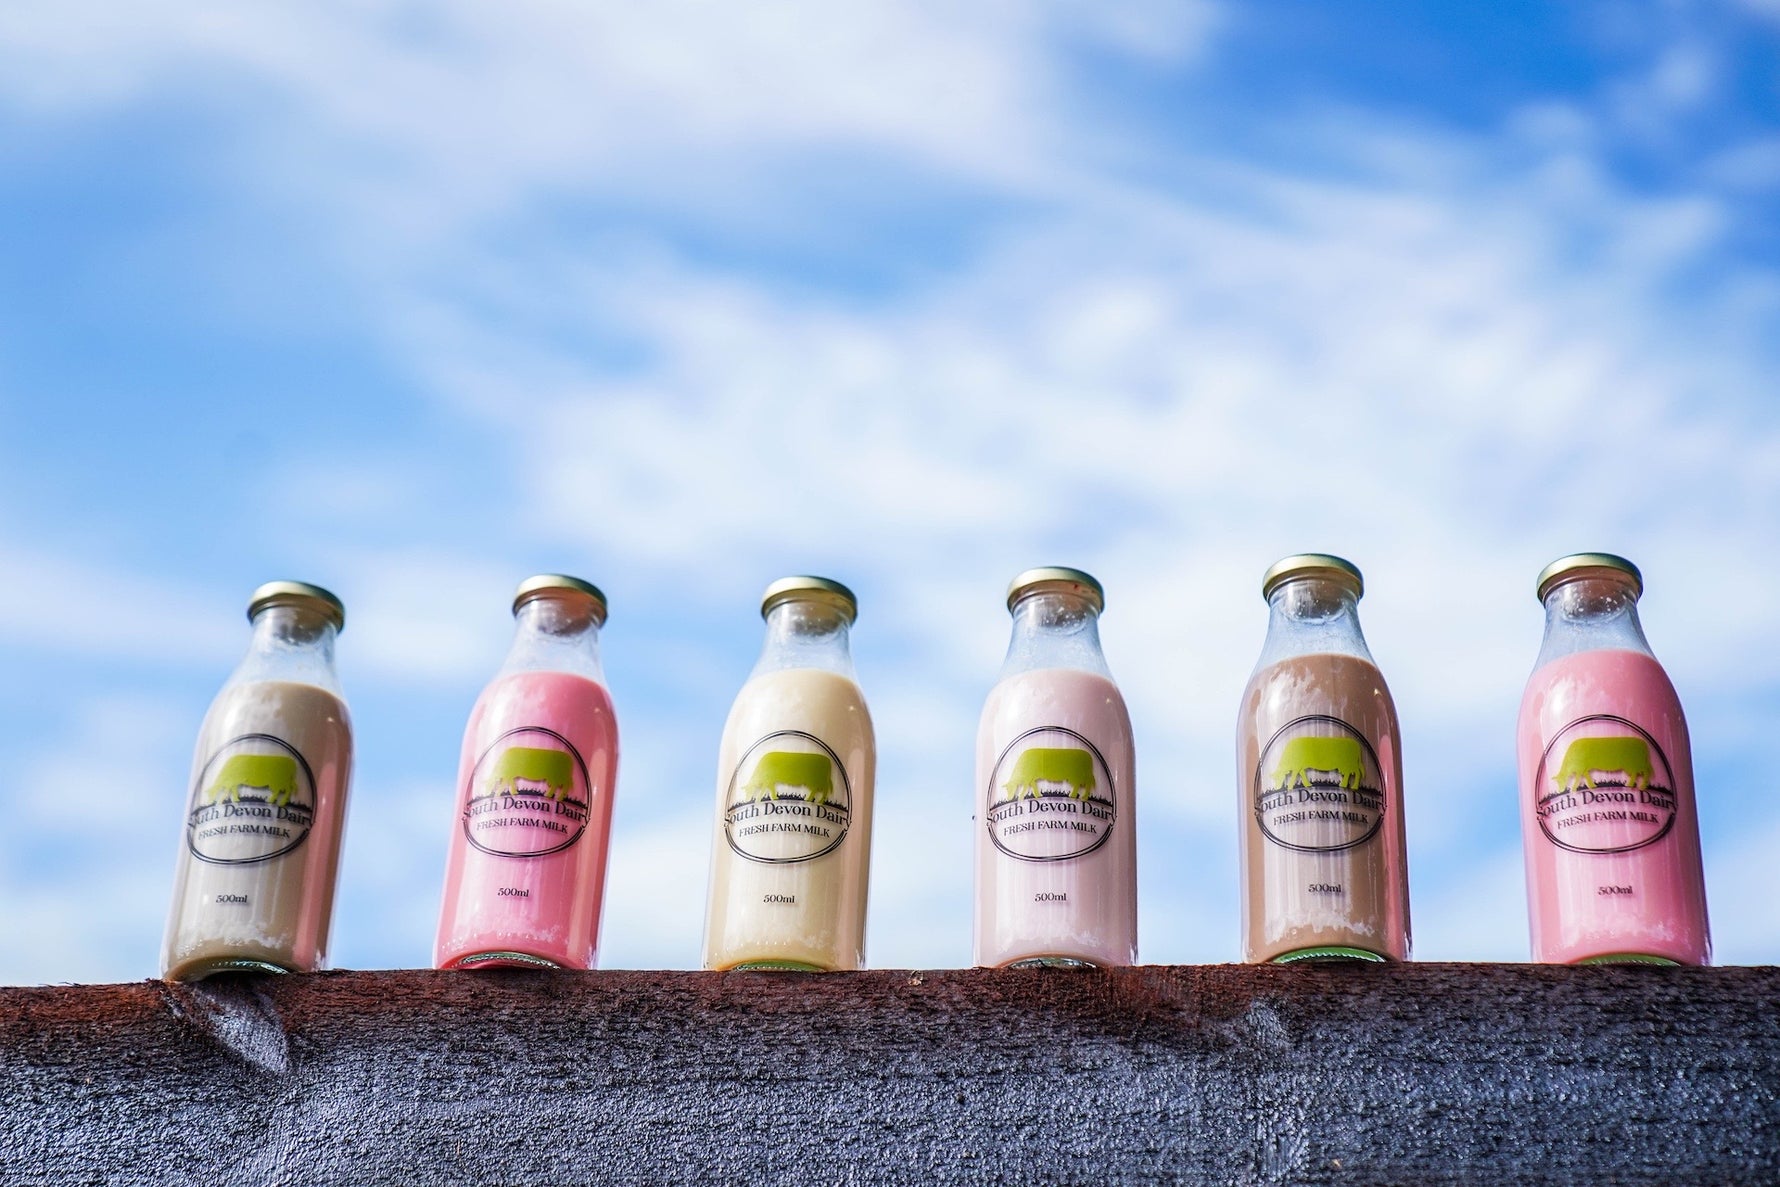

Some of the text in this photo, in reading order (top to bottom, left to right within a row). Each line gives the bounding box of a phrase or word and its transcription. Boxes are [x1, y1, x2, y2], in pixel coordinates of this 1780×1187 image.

[1298, 788, 1348, 804] Devon
[1582, 790, 1636, 805] Devon
[503, 796, 550, 813] Devon
[764, 801, 811, 816] Devon
[1028, 799, 1077, 814] Devon
[187, 807, 219, 829] uth
[223, 804, 272, 819] Devon
[1273, 810, 1369, 826] FRESH FARM MILK
[1557, 810, 1660, 829] FRESH FARM MILK
[198, 824, 291, 840] FRESH FARM MILK
[476, 817, 569, 835] FRESH FARM MILK
[739, 822, 831, 839] FRESH FARM MILK
[1003, 820, 1098, 837] FRESH FARM MILK
[497, 887, 530, 898] 500ml
[1308, 883, 1342, 893] 500ml
[1597, 885, 1634, 895] 500ml
[215, 894, 248, 904] 500ml
[763, 894, 795, 904] 500ml
[1034, 892, 1067, 902] 500ml
